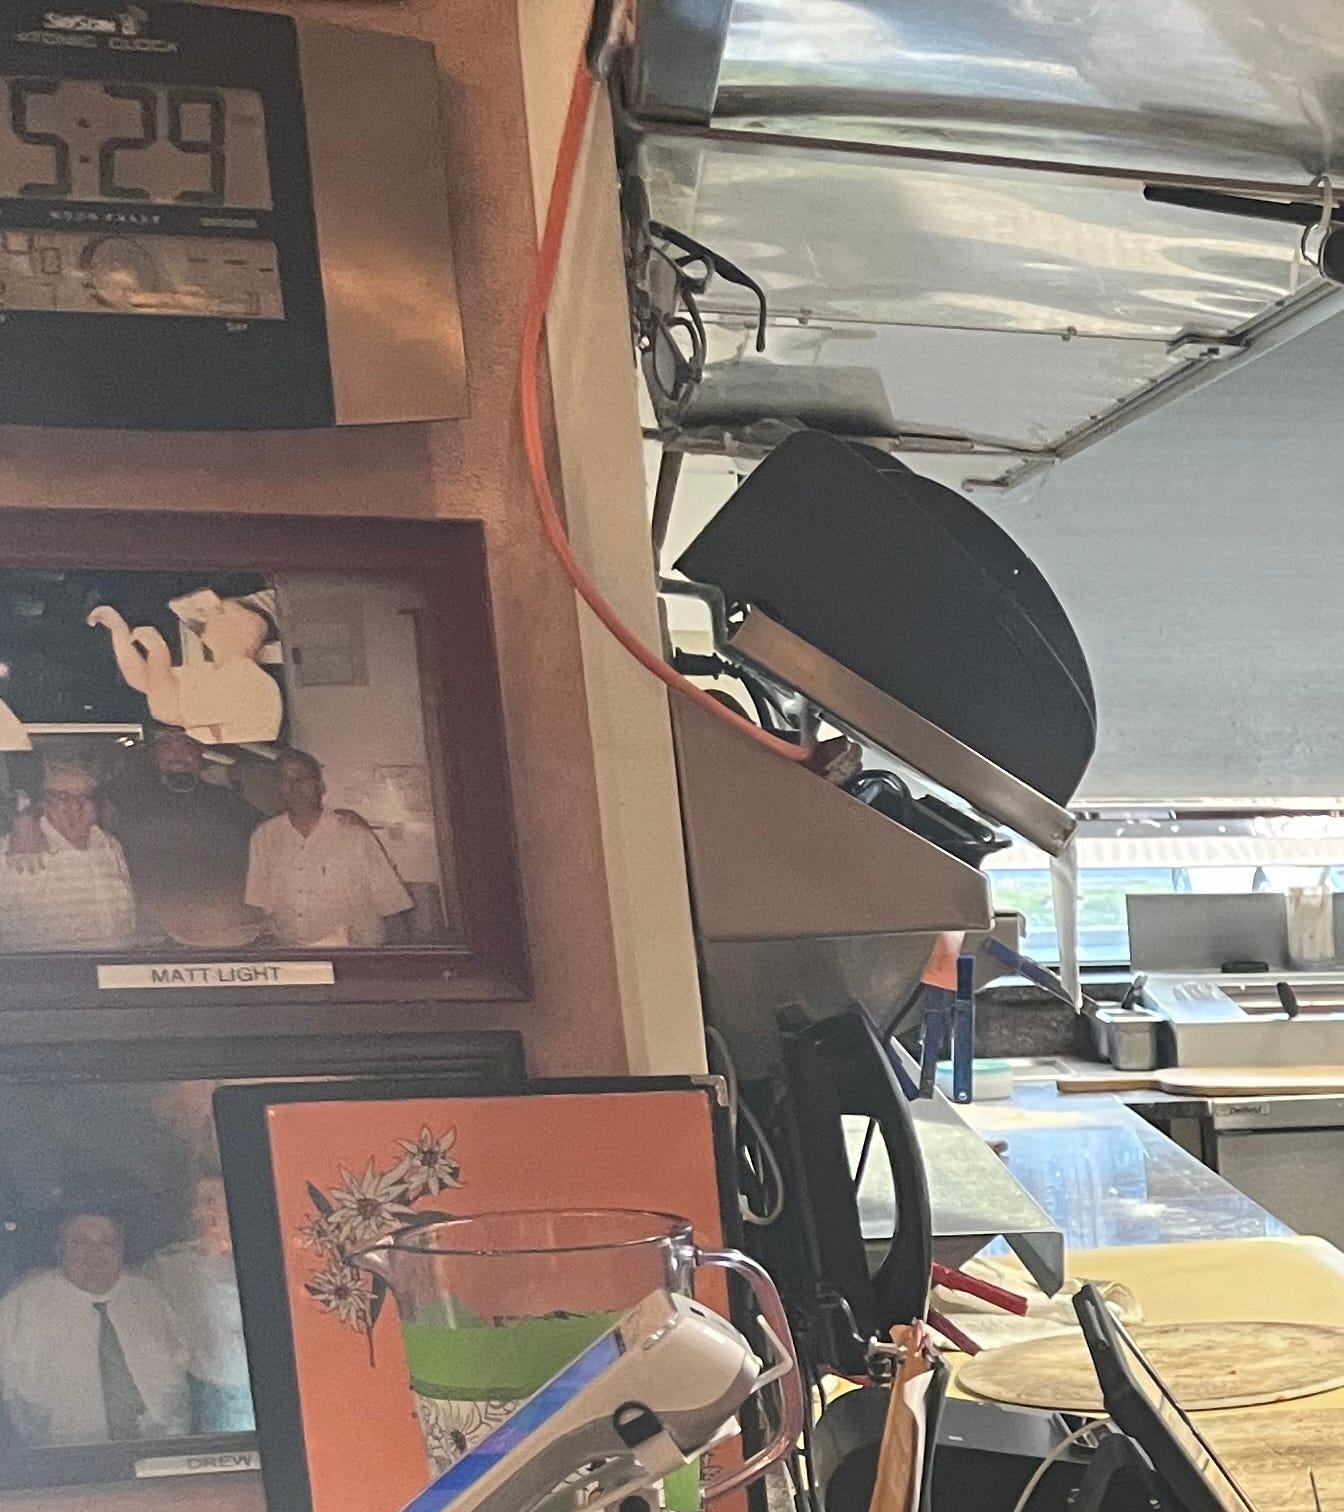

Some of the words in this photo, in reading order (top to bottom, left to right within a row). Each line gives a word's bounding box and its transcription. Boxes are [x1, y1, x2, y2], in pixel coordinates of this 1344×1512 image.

[107, 37, 178, 52] CLOCK
[151, 967, 210, 983] MATT
[219, 967, 282, 983] LIGHT
[187, 1455, 252, 1470] DREW
